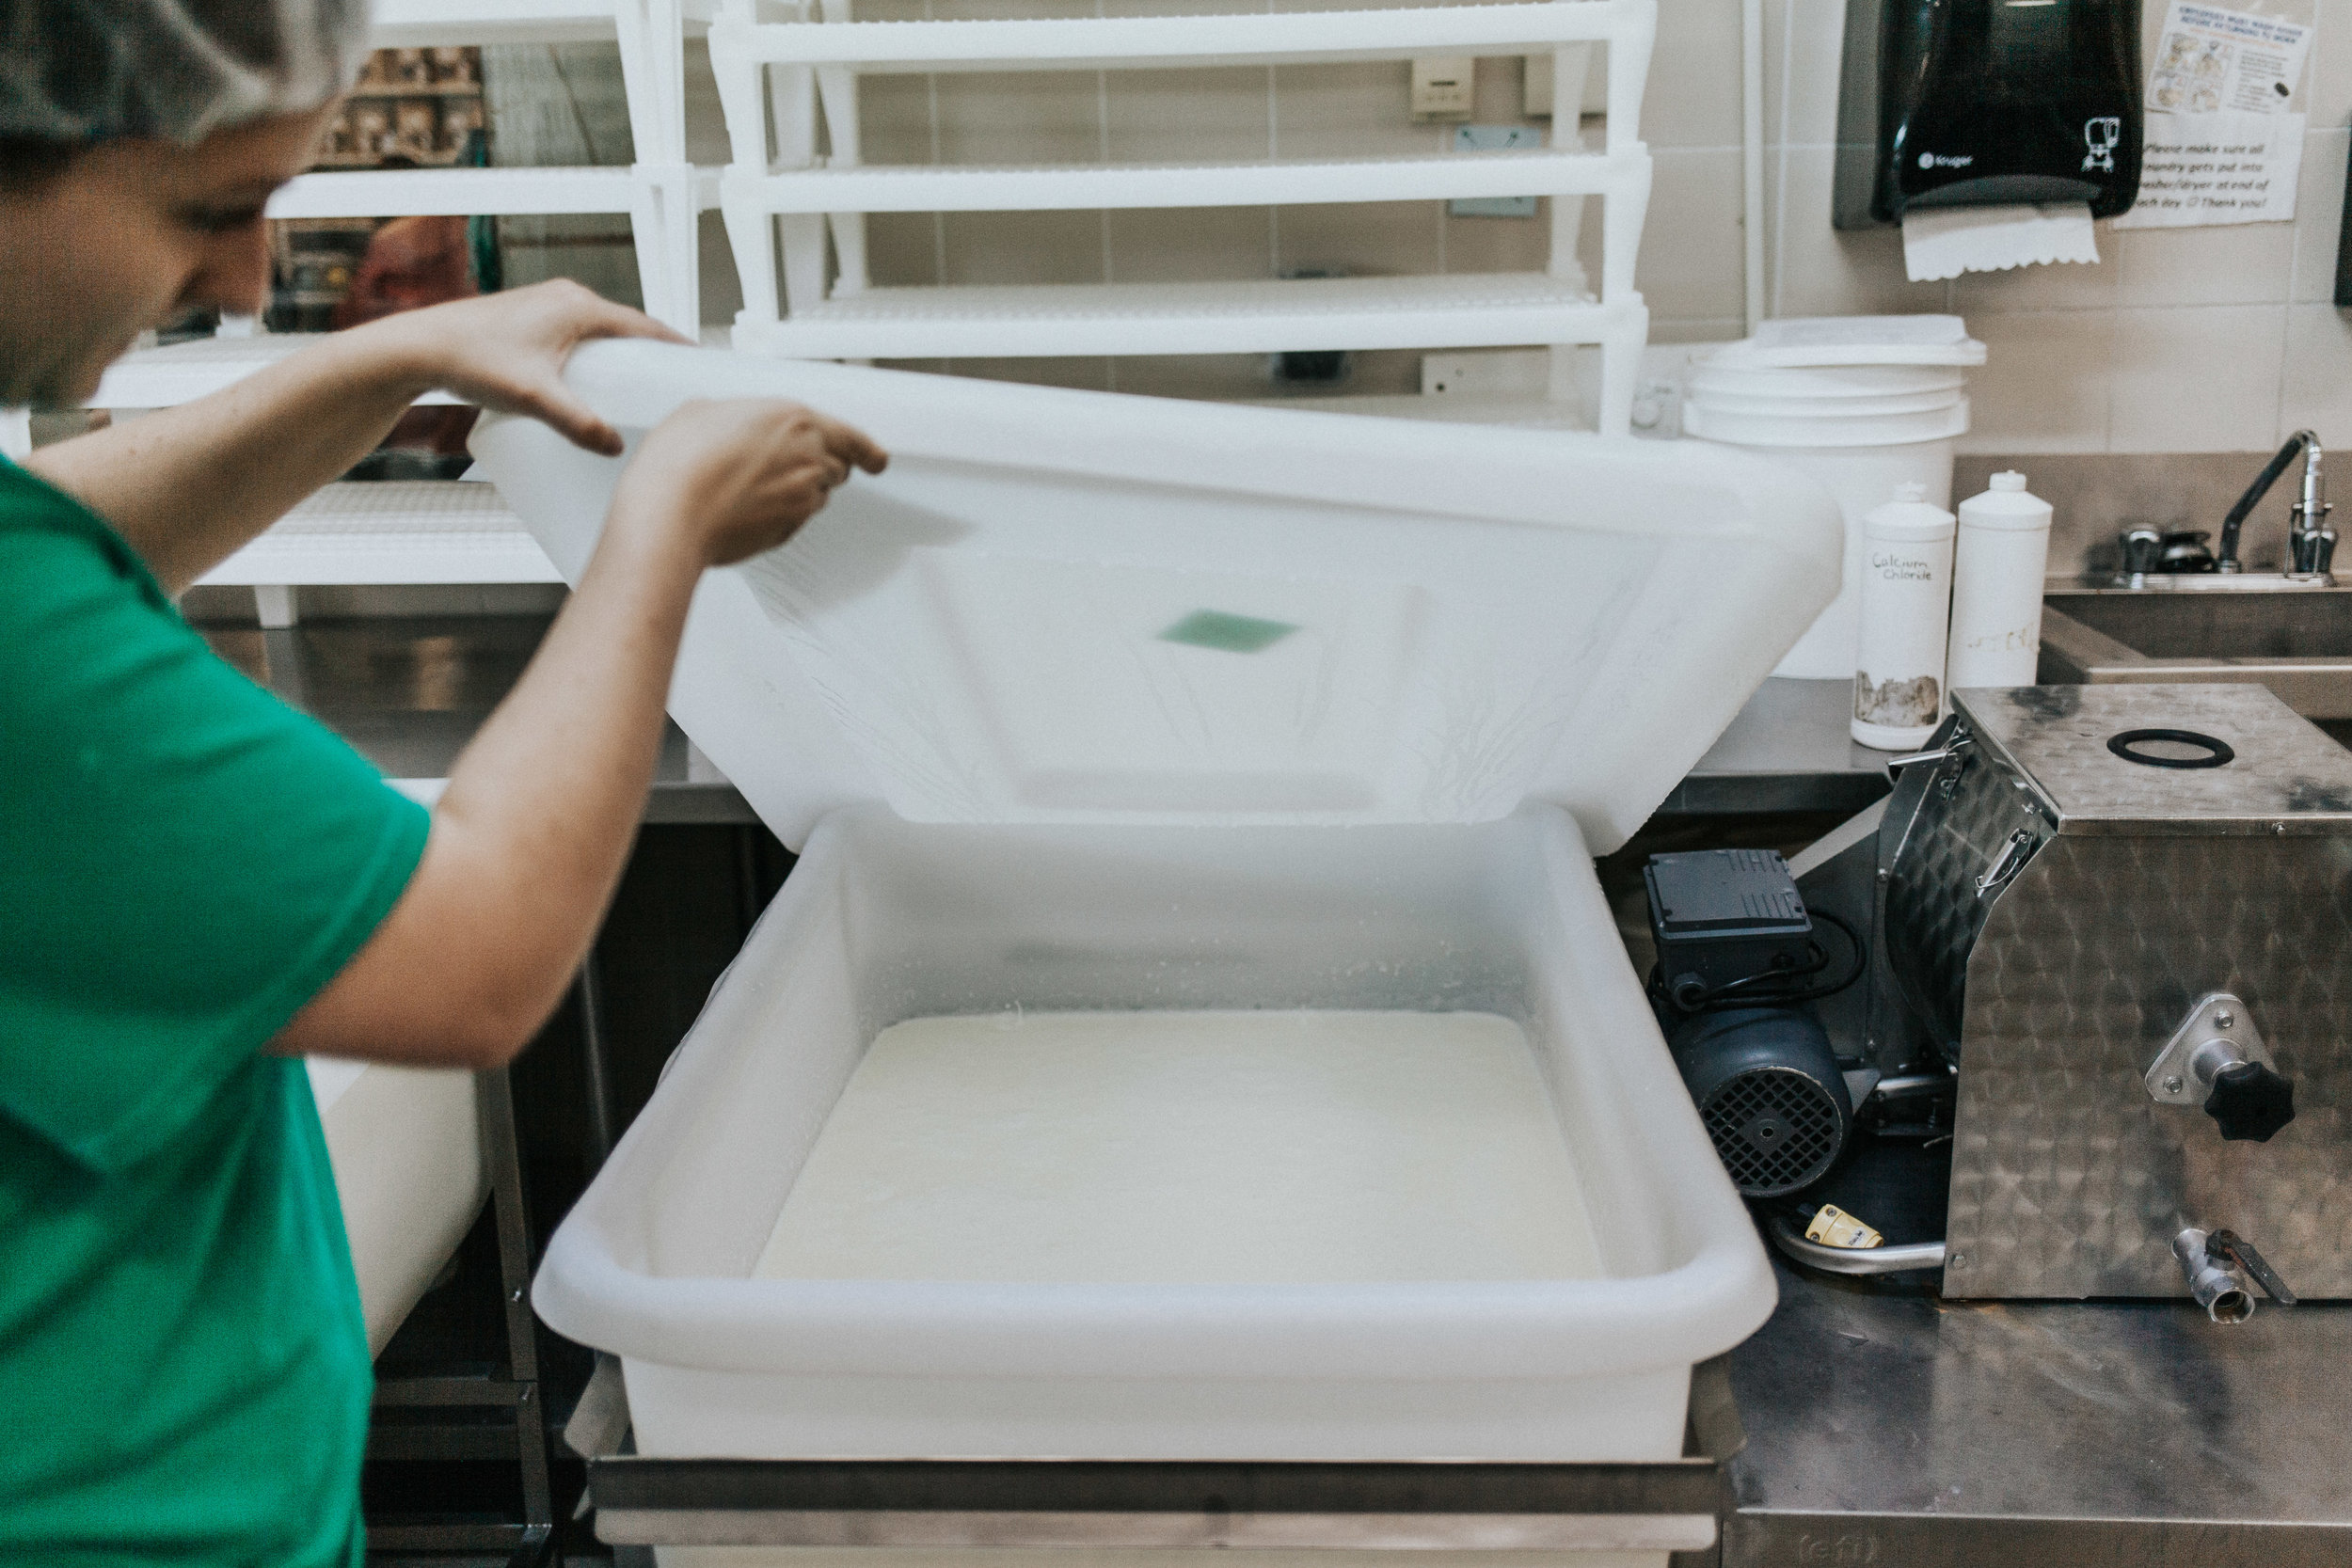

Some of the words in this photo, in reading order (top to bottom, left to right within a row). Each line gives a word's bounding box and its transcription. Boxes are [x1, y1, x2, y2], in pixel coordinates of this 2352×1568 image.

[2143, 143, 2183, 153] Please
[2185, 143, 2218, 153] make
[2223, 145, 2247, 154] sure
[2249, 143, 2265, 154] all
[1935, 154, 1974, 168] Kruger
[2188, 163, 2214, 173] gets
[2217, 163, 2237, 173] put
[2240, 163, 2264, 173] into
[2217, 180, 2229, 189] at
[2231, 180, 2253, 190] end
[2255, 179, 2270, 191] of
[2161, 197, 2182, 209] day
[2201, 197, 2236, 208] Thank
[2240, 197, 2267, 210] you!
[1872, 551, 1928, 569] Calcium
[1883, 568, 1933, 581] Chloride
